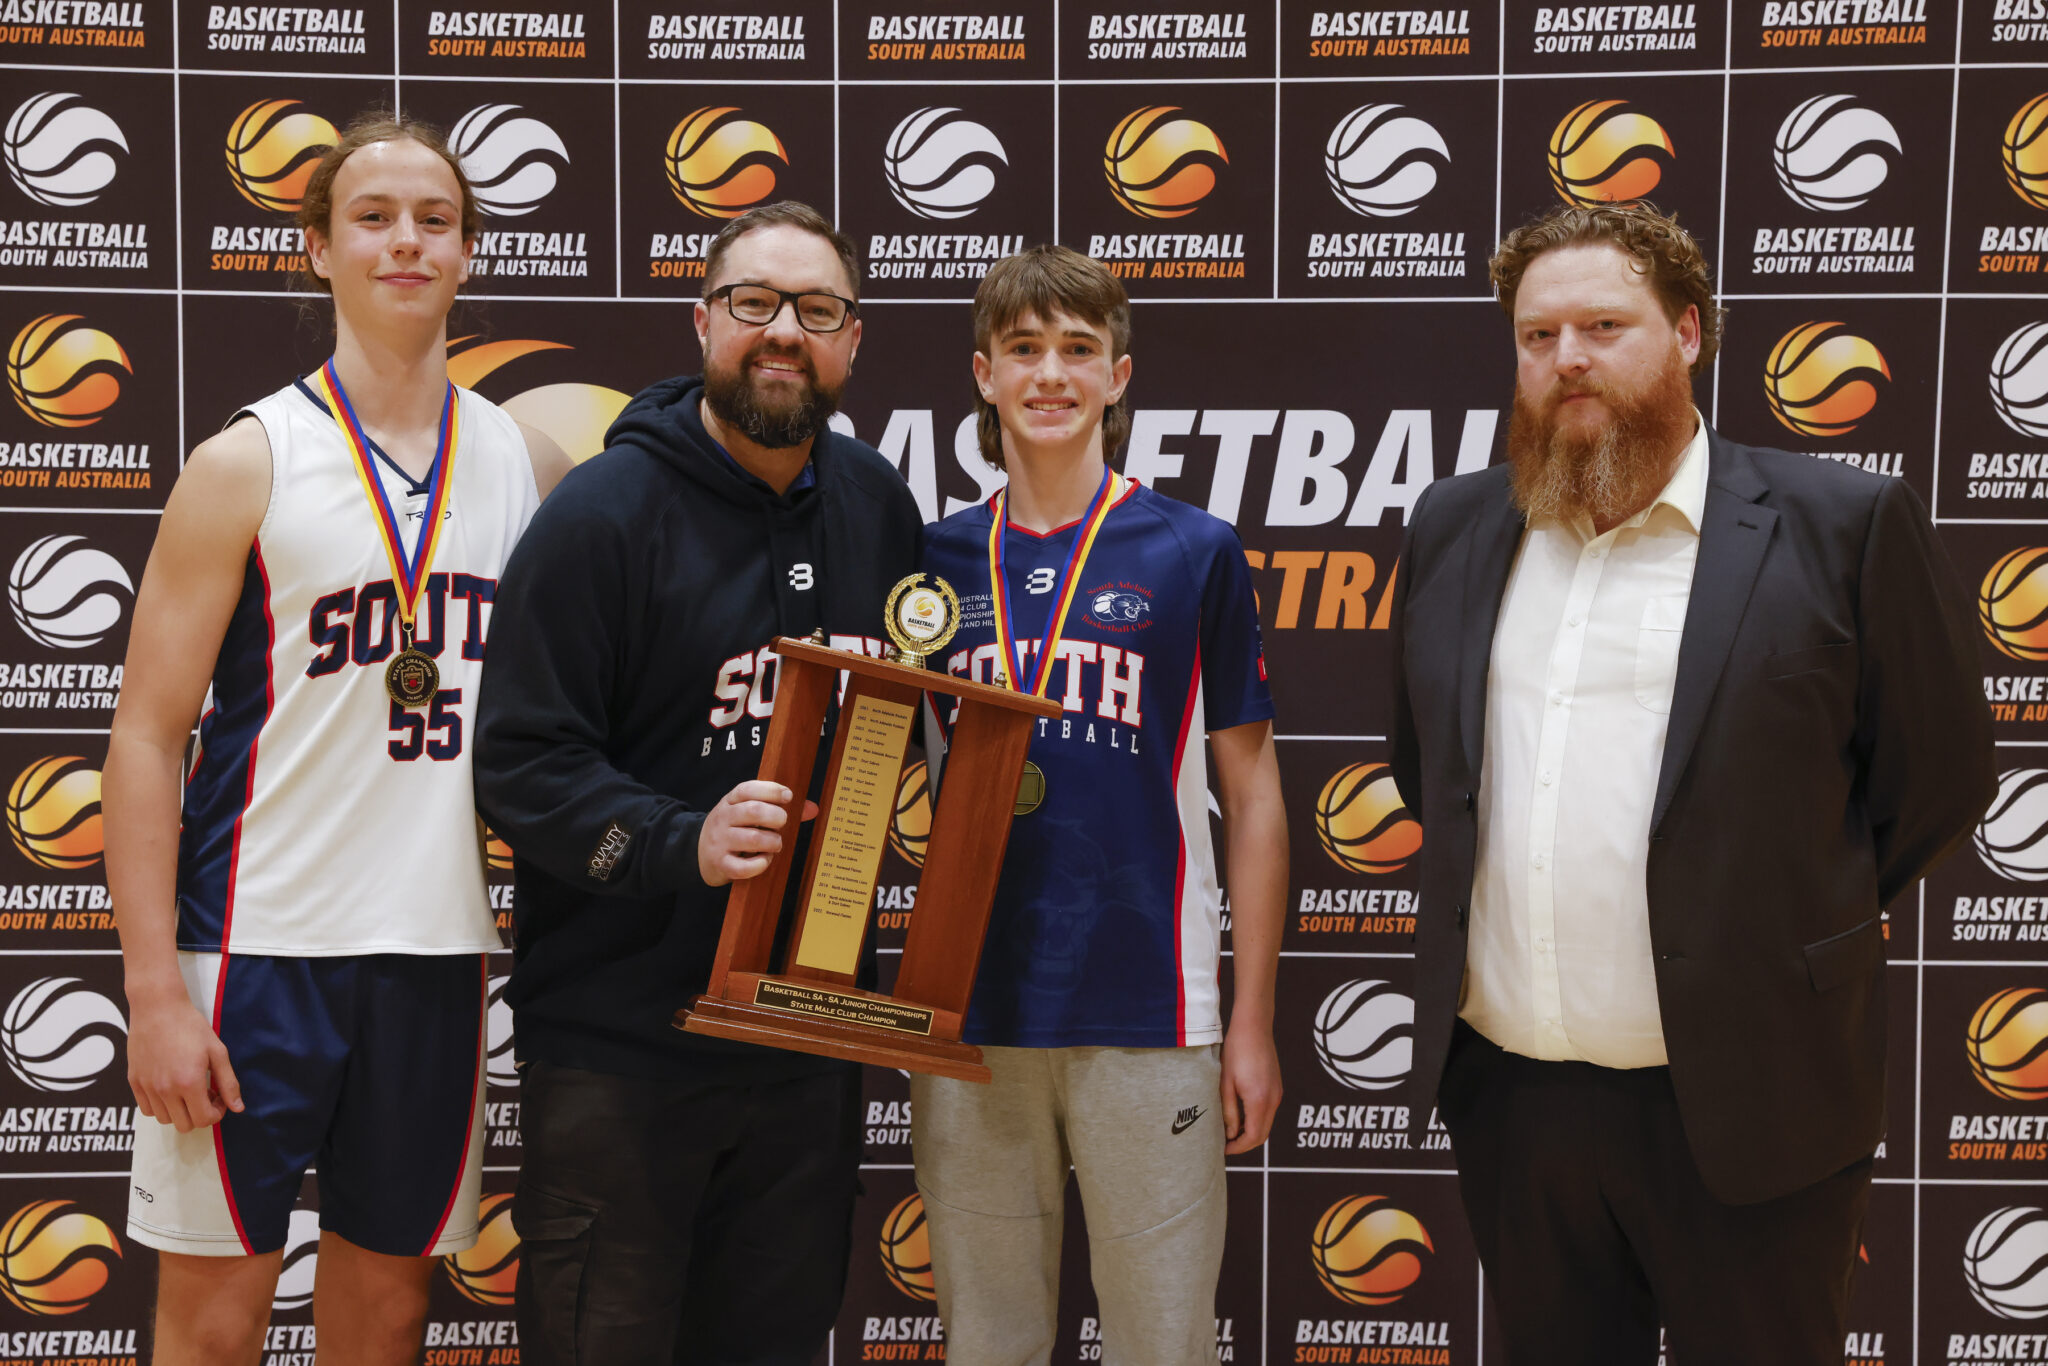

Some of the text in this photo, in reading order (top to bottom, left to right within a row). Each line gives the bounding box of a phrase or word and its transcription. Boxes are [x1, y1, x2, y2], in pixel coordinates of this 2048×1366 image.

[207, 5, 366, 34] BASKETBALL
[1310, 9, 1470, 37] BASKETBALL
[1534, 4, 1697, 33] BASKETBALL
[1761, 0, 1927, 27] BASKETBALL
[428, 11, 586, 38] BASKETBALL
[647, 14, 805, 40] BASKETBALL
[867, 15, 1025, 41] BASKETBALL
[1088, 13, 1247, 40] BASKETBALL
[48, 27, 145, 48] AUSTRALIA
[207, 32, 366, 54] SOUTH AUSTRALIA
[1533, 32, 1696, 53] SOUTH AUSTRALIA
[1760, 25, 1926, 48] SOUTH AUSTRALIA
[427, 38, 586, 58] SOUTH AUSTRALIA
[647, 42, 806, 60] SOUTH AUSTRALIA
[867, 43, 1026, 60] SOUTH AUSTRALIA
[1087, 41, 1247, 60] SOUTH AUSTRALIA
[1309, 37, 1470, 57] SOUTH AUSTRALIA
[1087, 234, 1245, 259] BASKETBALL
[1307, 232, 1466, 258] BASKETBALL
[1753, 226, 1915, 253] BASKETBALL
[52, 249, 149, 269] AUSTRALIA
[210, 253, 270, 271] SOUTH
[492, 259, 588, 277] AUSTRALIA
[1307, 260, 1466, 278] SOUTH AUSTRALIA
[1752, 255, 1914, 274] SOUTH AUSTRALIA
[1978, 254, 2040, 273] SOUTH
[649, 261, 708, 278] SOUTH
[868, 262, 927, 279] SOUTH
[1149, 261, 1245, 279] AUSTRALIA
[55, 471, 151, 489] AUSTRALIA
[1966, 481, 2028, 499] SOUTH
[1116, 581, 1155, 599] Adelaide
[966, 603, 987, 611] CLUB
[1081, 613, 1153, 632] Basketball Club
[392, 658, 433, 681] STATE CHAMPION
[388, 688, 462, 761] 55
[591, 823, 622, 868] QUALITY
[1298, 915, 1356, 933] SOUTH
[1952, 923, 2012, 941] SOUTH
[763, 984, 927, 1020] BASKETBALL SA SA JUNIOR CHAMPIONSHIPS
[790, 1000, 897, 1026] STATE MALE CLUB CHAMPION
[1176, 1104, 1199, 1124] NIKE
[1297, 1131, 1354, 1148] SOUTH
[1948, 1142, 2007, 1160] SOUTH
[1295, 1319, 1450, 1346] BASKETBALL
[424, 1349, 483, 1366] SOUTH
[862, 1344, 920, 1361] SOUTH
[1295, 1346, 1450, 1366] SOUTH AUSTRALIA
